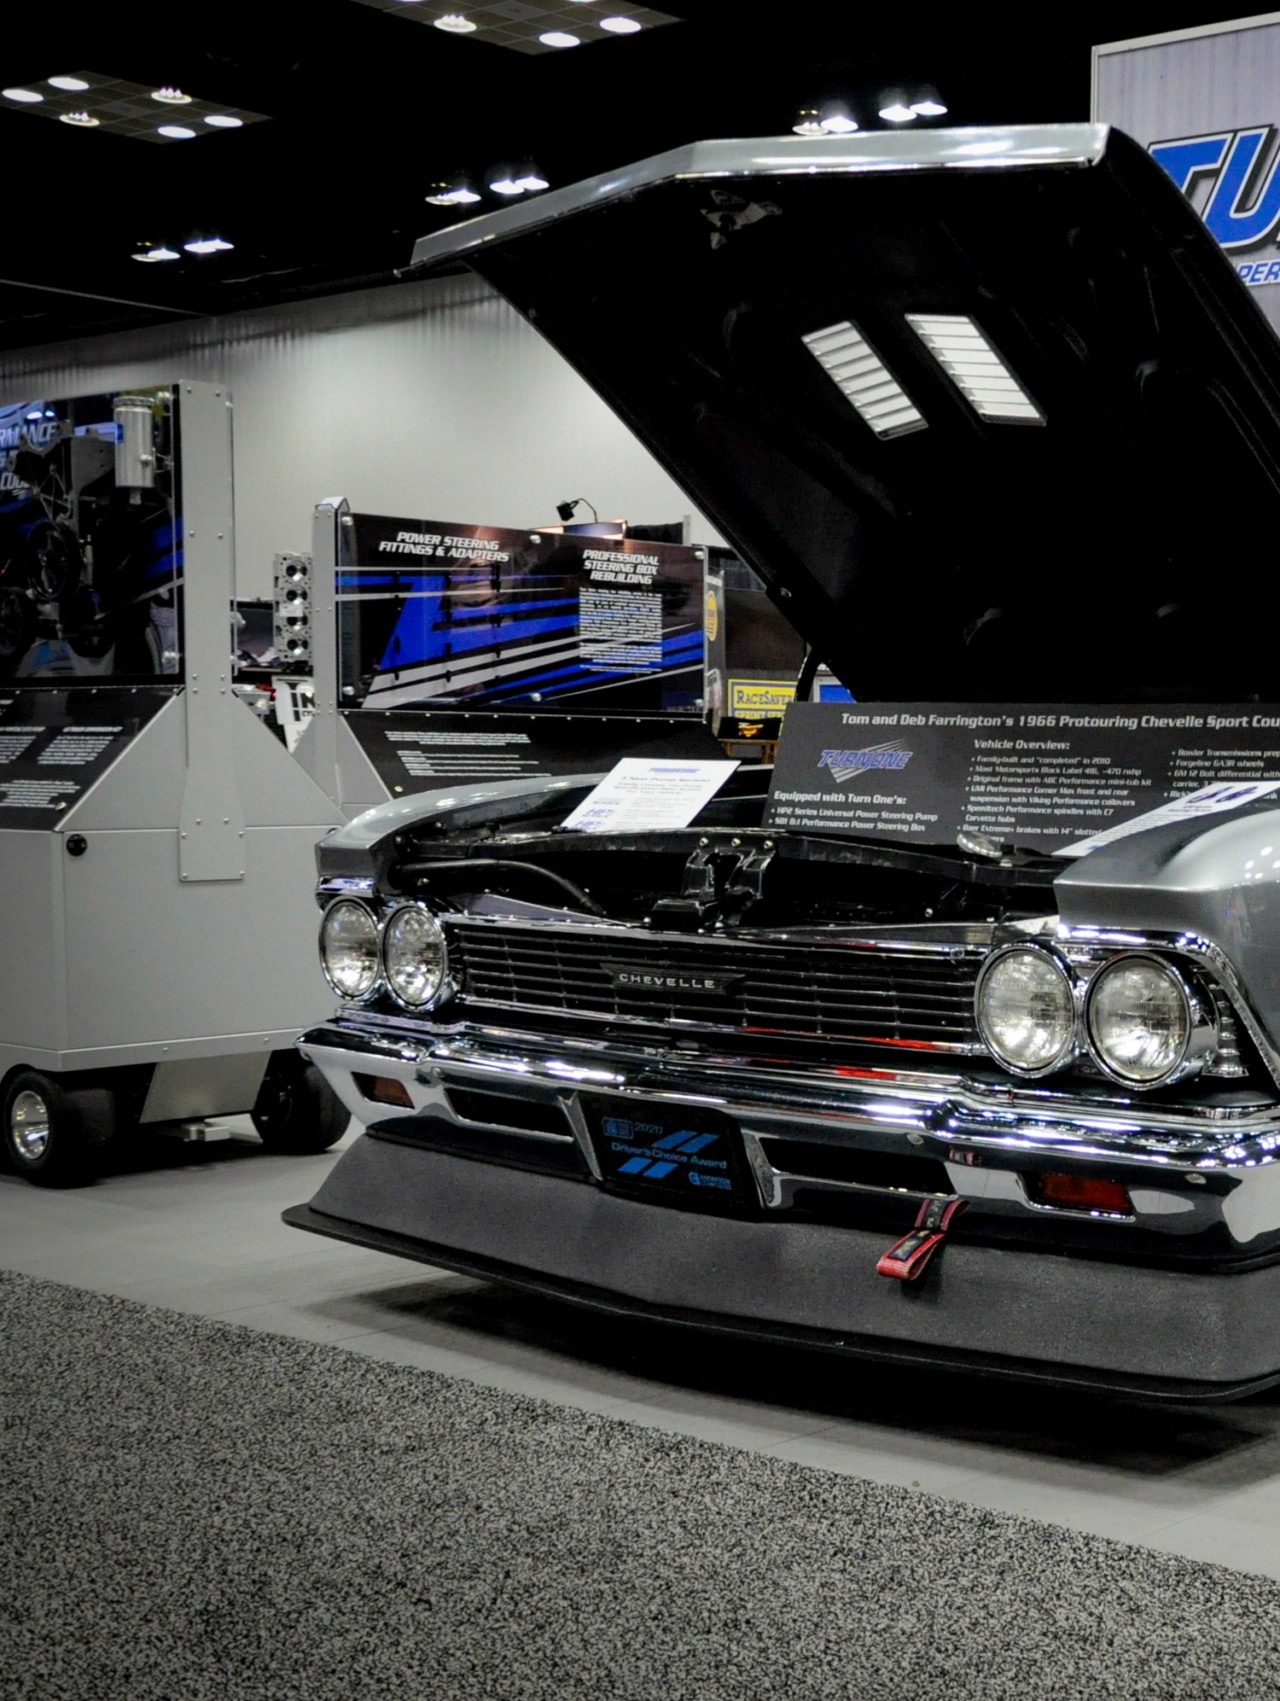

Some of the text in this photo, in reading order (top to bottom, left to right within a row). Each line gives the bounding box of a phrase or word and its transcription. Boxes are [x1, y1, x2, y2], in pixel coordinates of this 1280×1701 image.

[397, 531, 500, 551] POWER STEERING
[379, 541, 510, 562] FITTINGS & ADAPTERS
[582, 549, 659, 565] PROFESSIONAL
[583, 560, 658, 575] STEERING BOX
[590, 570, 652, 584] REBUILDING
[841, 713, 870, 725] Tom
[872, 714, 897, 725] and
[900, 714, 925, 725] Deb
[928, 714, 1013, 729] Farrington's
[1019, 715, 1056, 726] 1966
[1059, 715, 1137, 730] Protouring
[1141, 715, 1203, 728] Chevelle
[1206, 715, 1249, 730] Sport
[974, 739, 1070, 750] Vehicle Overview:
[1206, 749, 1262, 757] Transmissions
[818, 750, 914, 770] TURNONE
[977, 756, 1018, 764] Family-built
[1092, 757, 1111, 765] 2010
[1176, 760, 1212, 768] Forgeline
[995, 766, 1039, 774] Motorsports
[1217, 770, 1261, 778] differential
[973, 775, 1000, 784] Original
[1059, 777, 1106, 785] Performance
[774, 791, 907, 805] Equipped with Turn One's:
[970, 796, 1010, 804] suspension
[1029, 797, 1051, 805] Viking
[1052, 797, 1100, 805] Performance
[1101, 798, 1135, 806] coilovers
[794, 807, 818, 816] Series
[819, 809, 854, 818] Universal
[855, 811, 879, 819] Power
[881, 811, 913, 822] Steering
[914, 813, 938, 822] Pump
[967, 804, 1004, 813] Speedtech
[1005, 806, 1052, 814] Performance
[1053, 807, 1084, 816] spindles
[965, 814, 1016, 823] Corvette hubs
[802, 819, 849, 828] Performance
[851, 820, 875, 829] Power
[877, 822, 909, 832] Steering
[910, 823, 925, 832] Box
[619, 973, 715, 989] CHEVELLE
[635, 1122, 663, 1135] 2020
[611, 1140, 727, 1169] Driver's Choice Award
